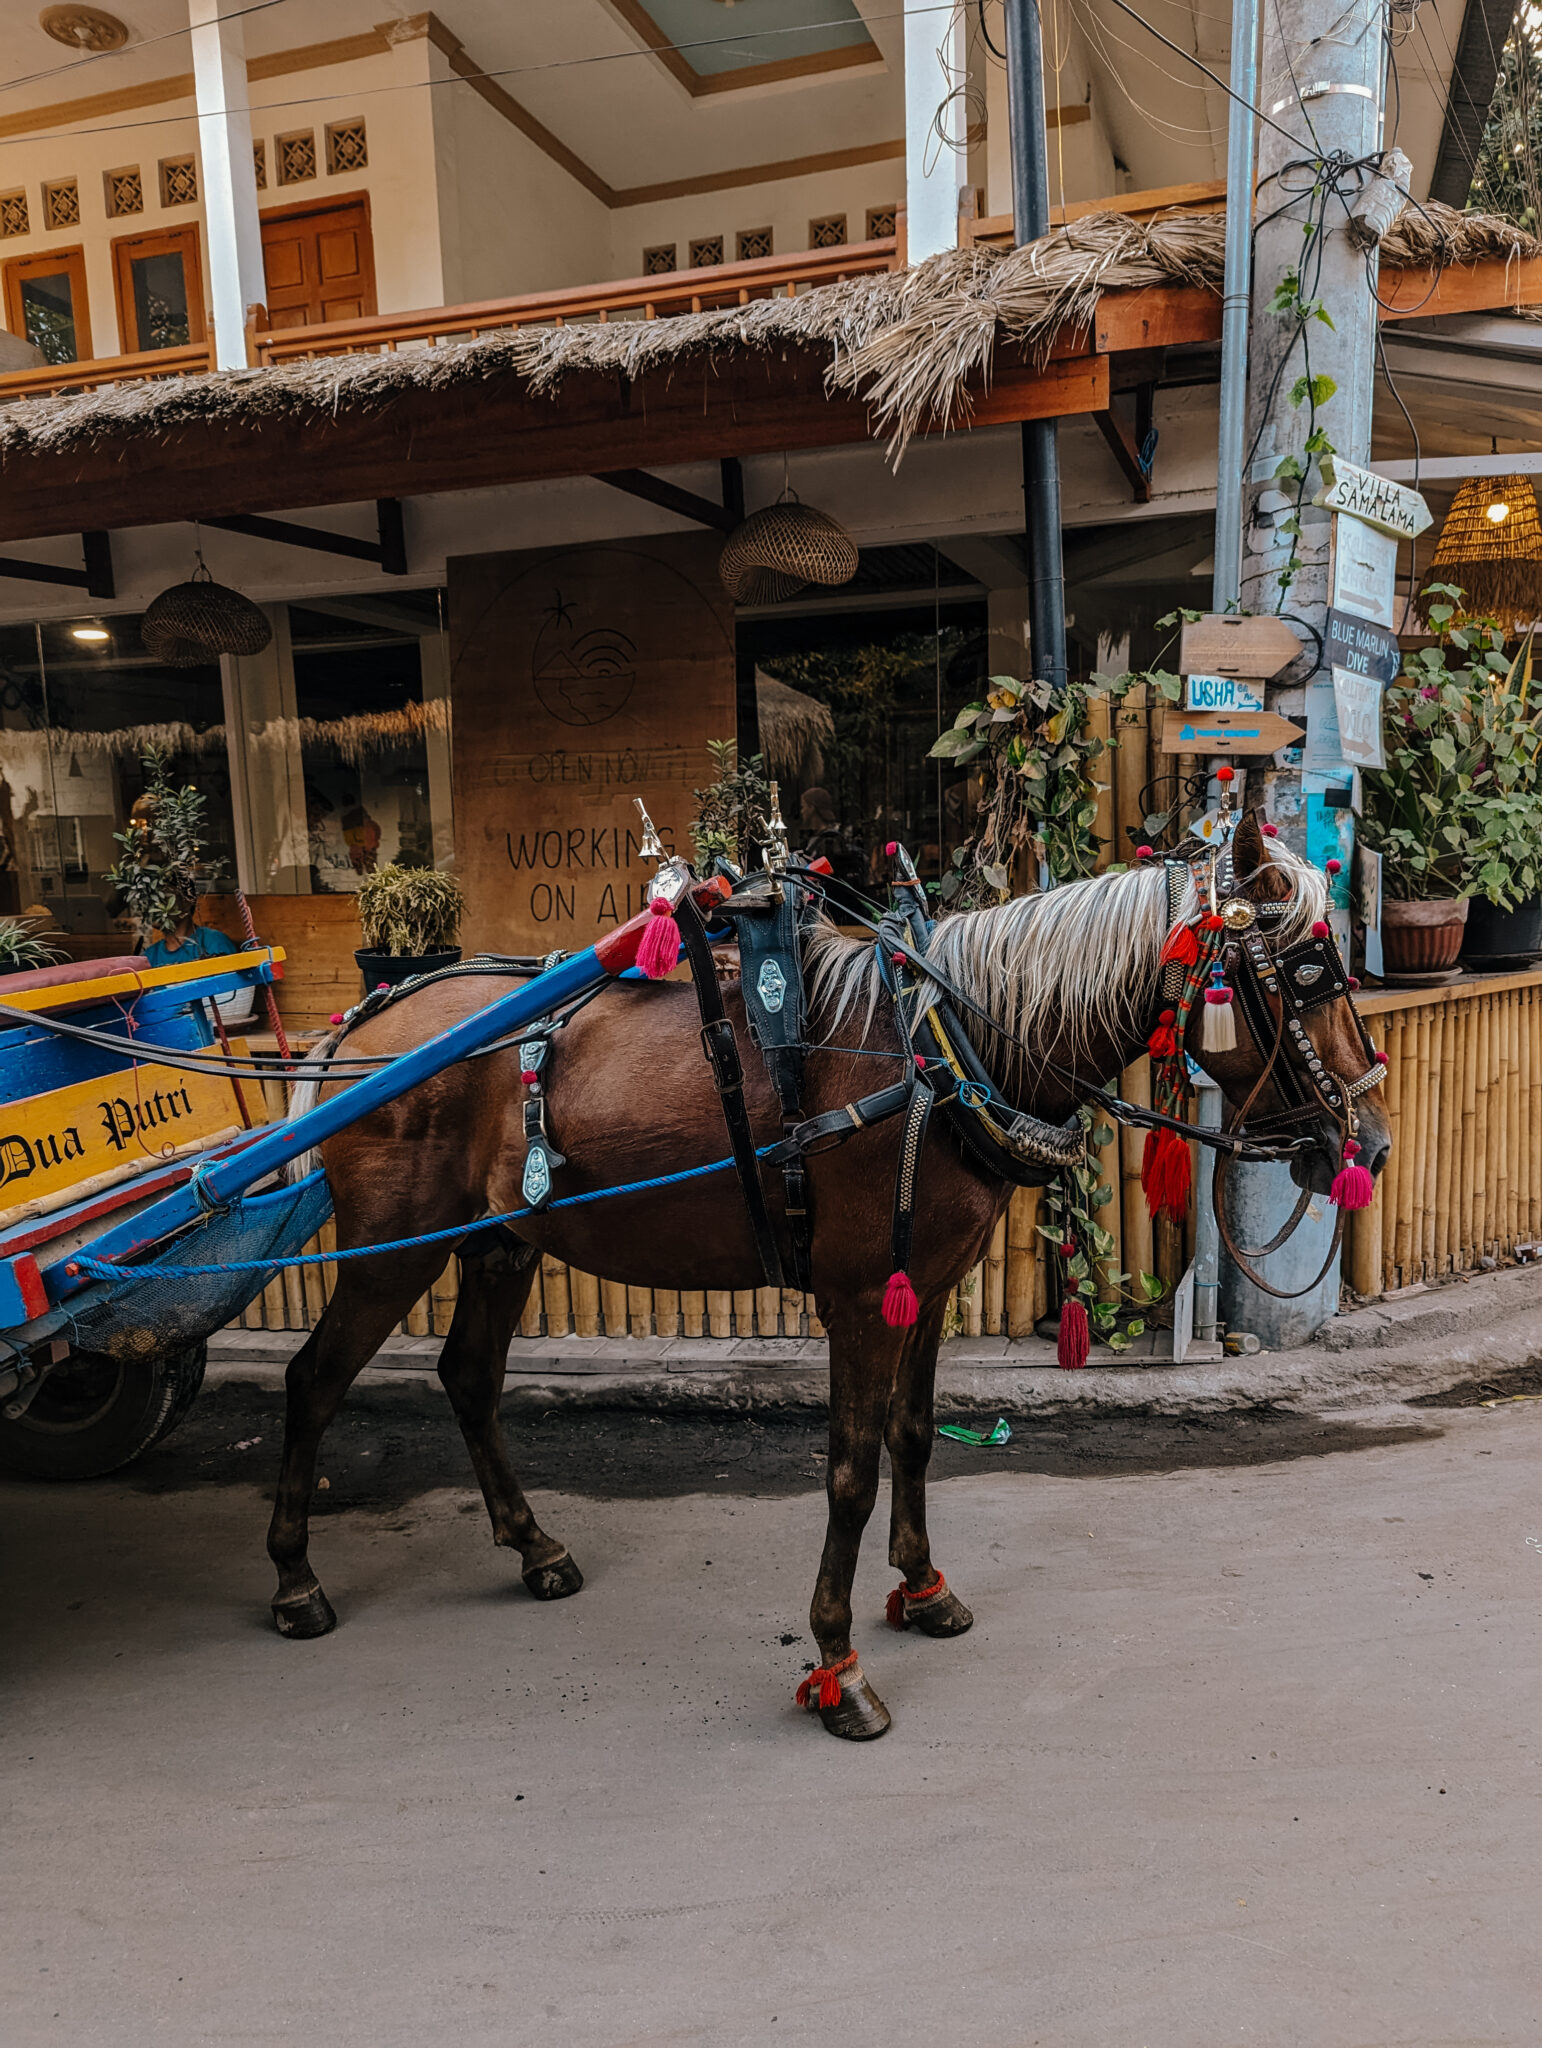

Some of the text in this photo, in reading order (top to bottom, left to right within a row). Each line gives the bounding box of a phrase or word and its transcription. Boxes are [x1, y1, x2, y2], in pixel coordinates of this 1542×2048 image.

[1331, 619, 1390, 659] BLUE MARLIN
[1346, 649, 1370, 674] DIVE
[1192, 680, 1235, 707] USHA
[529, 752, 593, 784] OPEN
[605, 751, 651, 785] NOW
[506, 826, 677, 871] WORKING
[530, 883, 575, 922] ON
[0, 1078, 193, 1189] Dua Putri
